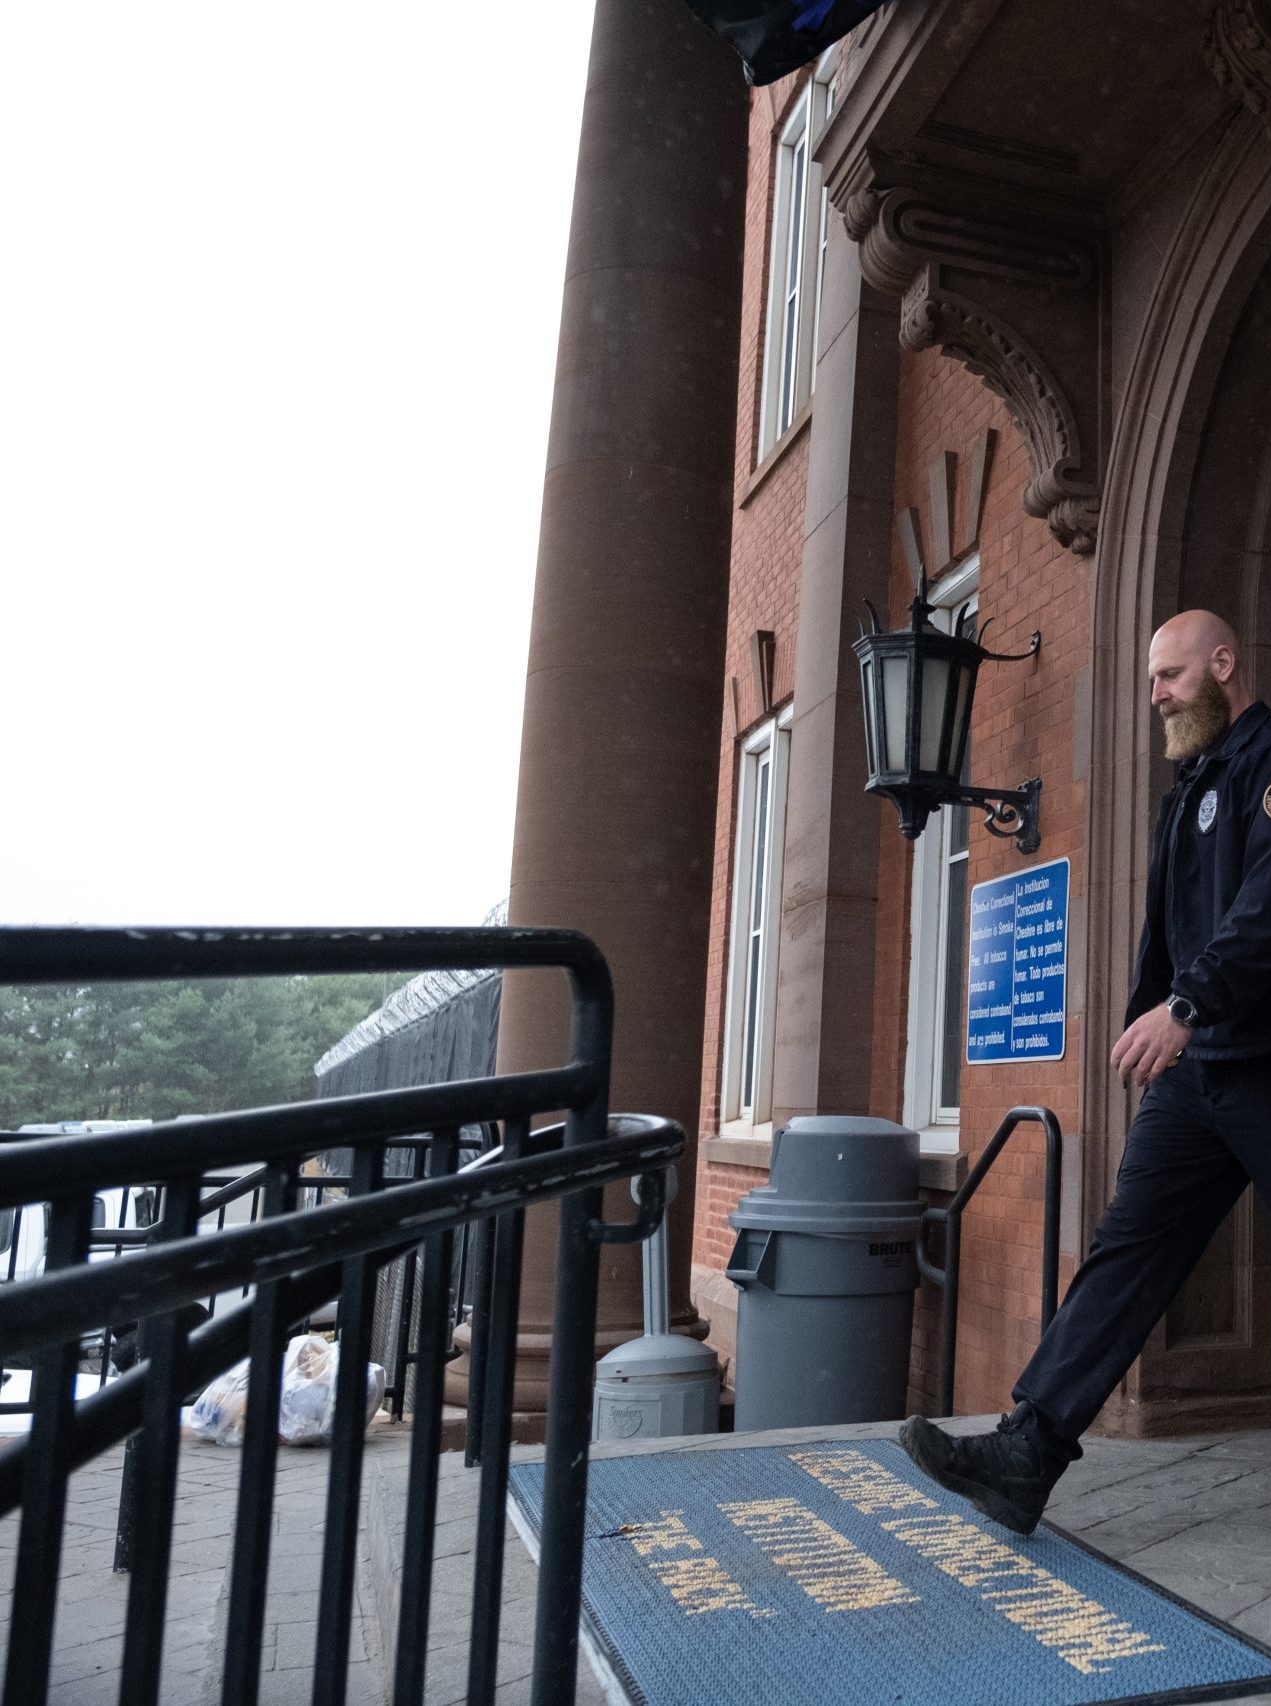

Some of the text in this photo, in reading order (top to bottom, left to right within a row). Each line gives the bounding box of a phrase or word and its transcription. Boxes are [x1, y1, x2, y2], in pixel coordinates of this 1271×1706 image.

[999, 921, 1013, 935] Smoke
[1017, 924, 1035, 940] Cheshire
[1037, 924, 1042, 935] es
[1056, 916, 1063, 930] de
[1030, 945, 1036, 958] No
[1038, 946, 1043, 957] se
[1030, 966, 1040, 980] Todo
[869, 1241, 912, 1256] BRUTE
[717, 1498, 921, 1613] INSTITUTION
[786, 1450, 1167, 1675] CHESHIRE CORRECTIONAL
